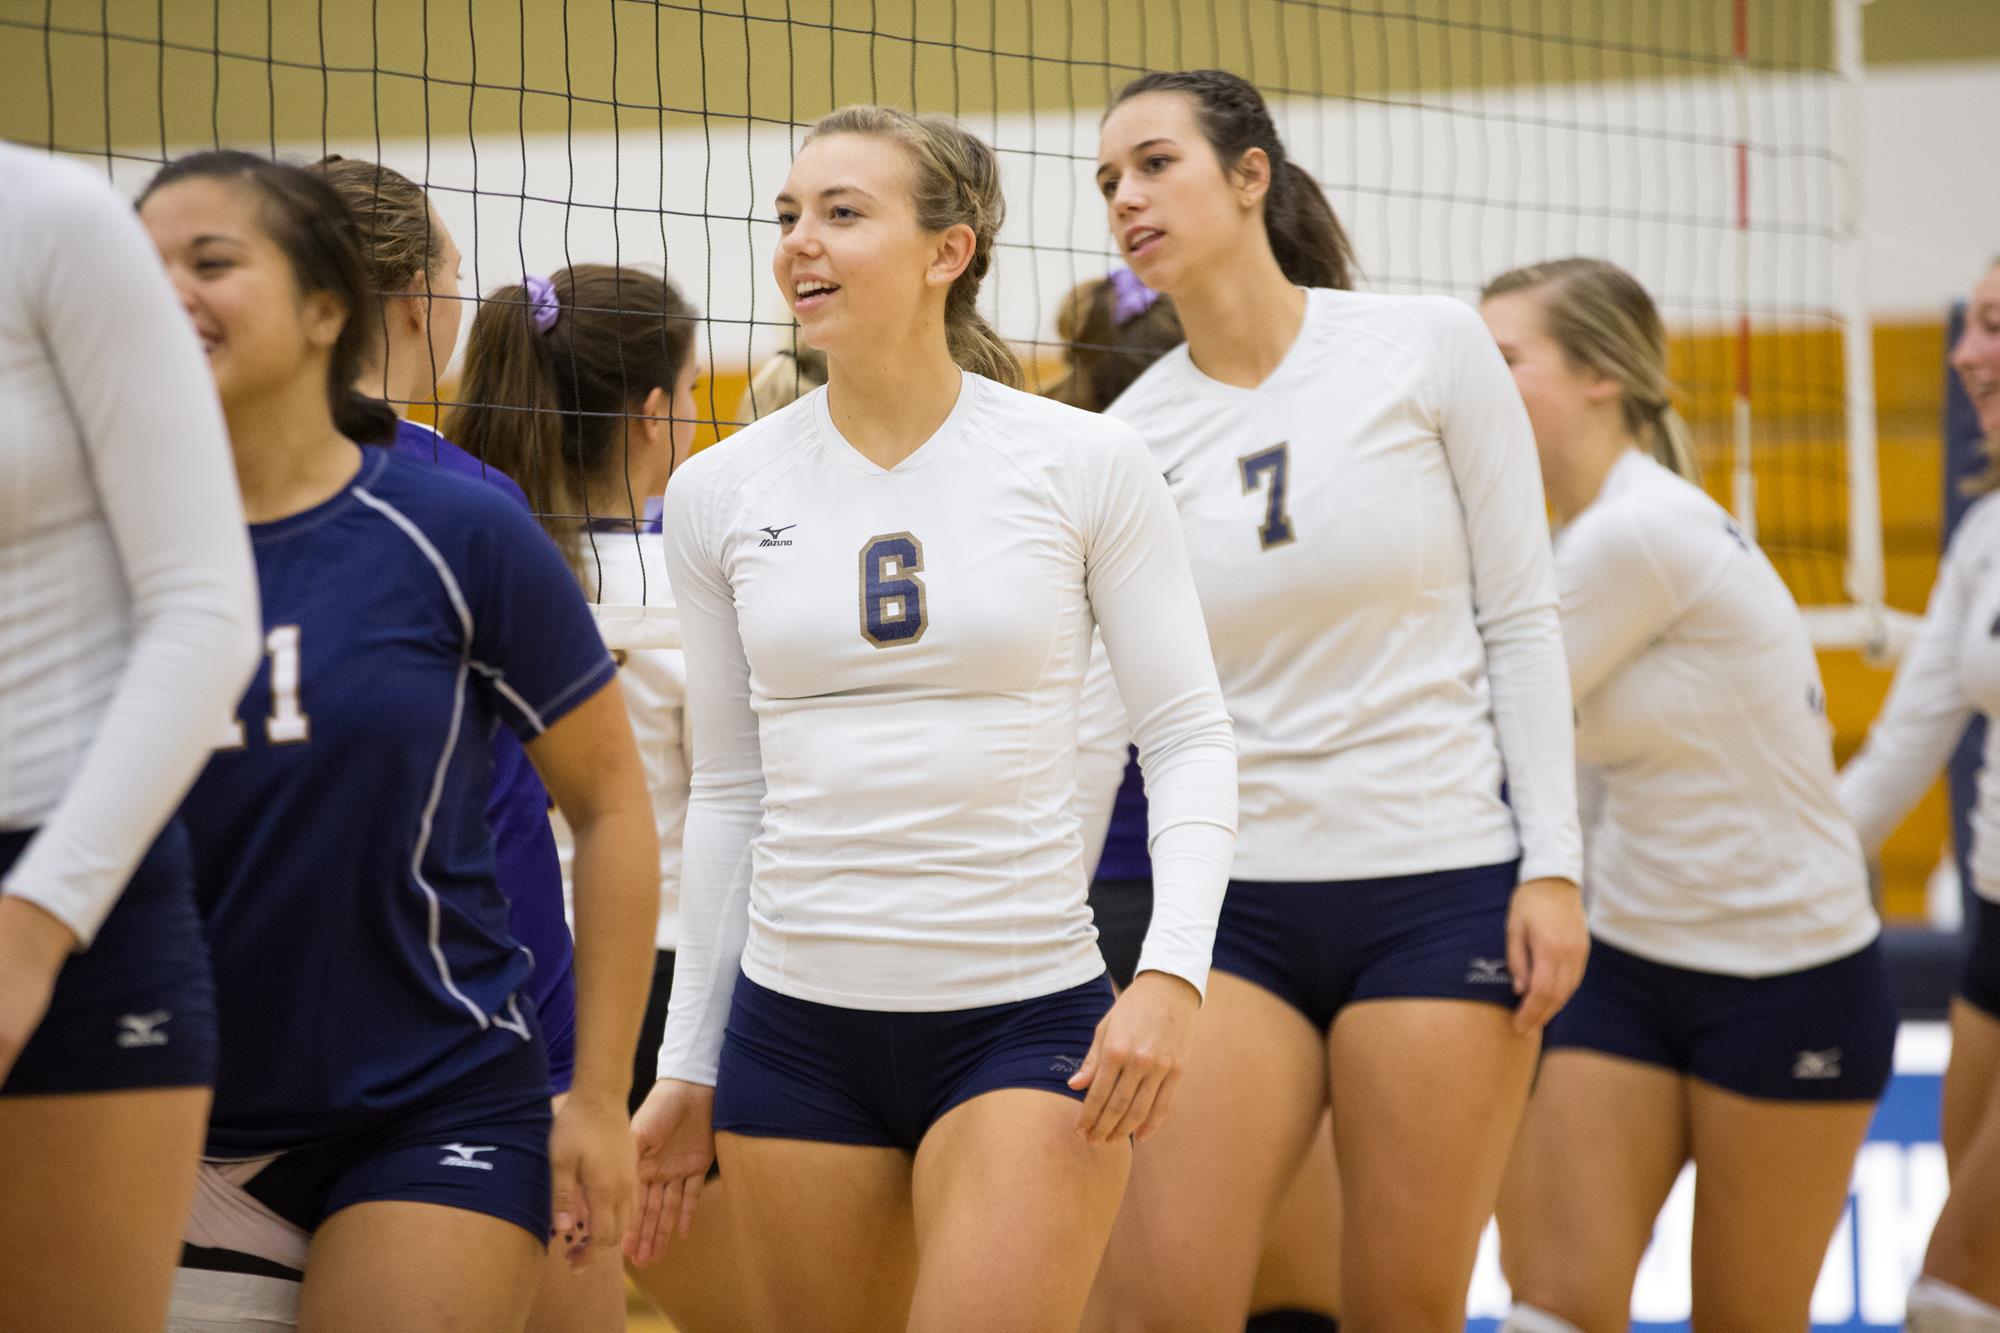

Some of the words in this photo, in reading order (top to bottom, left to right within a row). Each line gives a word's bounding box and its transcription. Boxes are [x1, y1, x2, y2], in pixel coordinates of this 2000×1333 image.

[1238, 441, 1297, 552] 7
[859, 531, 928, 649] 6
[218, 624, 310, 750] 1
